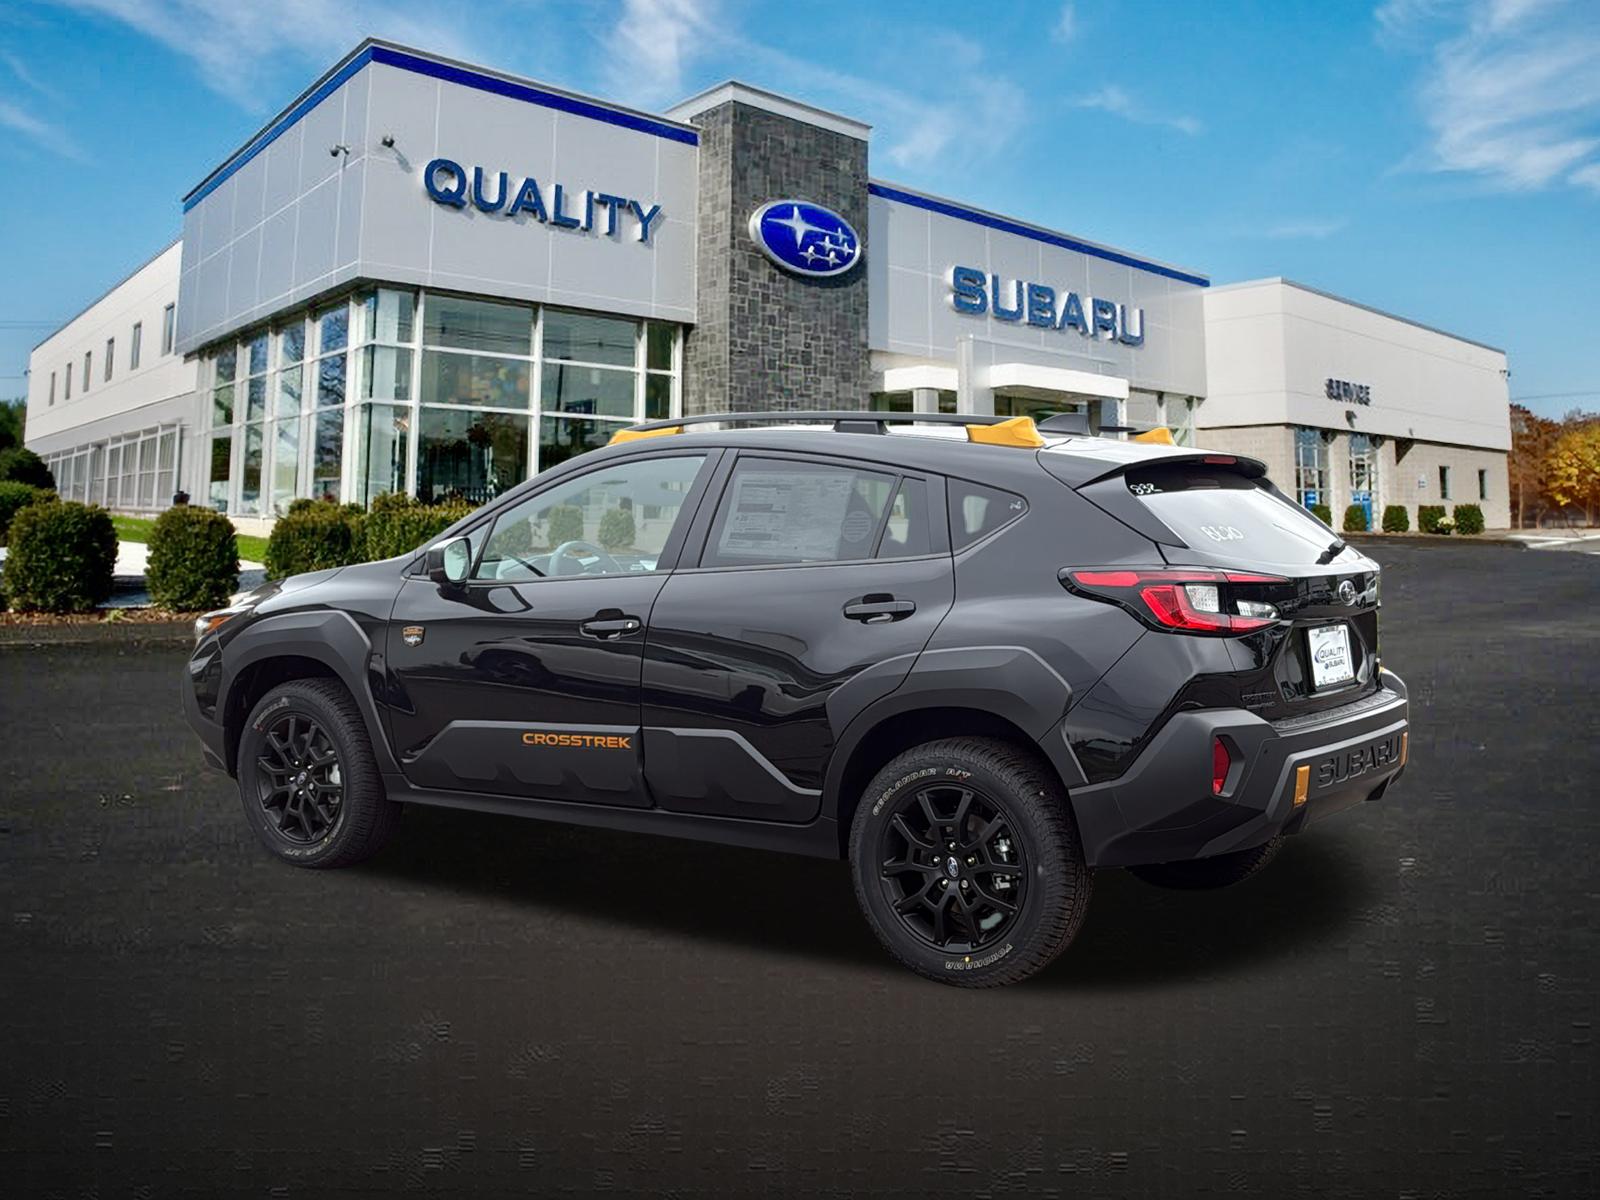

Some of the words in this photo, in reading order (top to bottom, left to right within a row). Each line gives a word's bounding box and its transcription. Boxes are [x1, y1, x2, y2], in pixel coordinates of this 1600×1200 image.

[423, 158, 662, 243] QUALITY
[950, 265, 1145, 347] SUBARU
[522, 732, 632, 750] CROSSTREK
[1317, 735, 1401, 789] SUBARU
